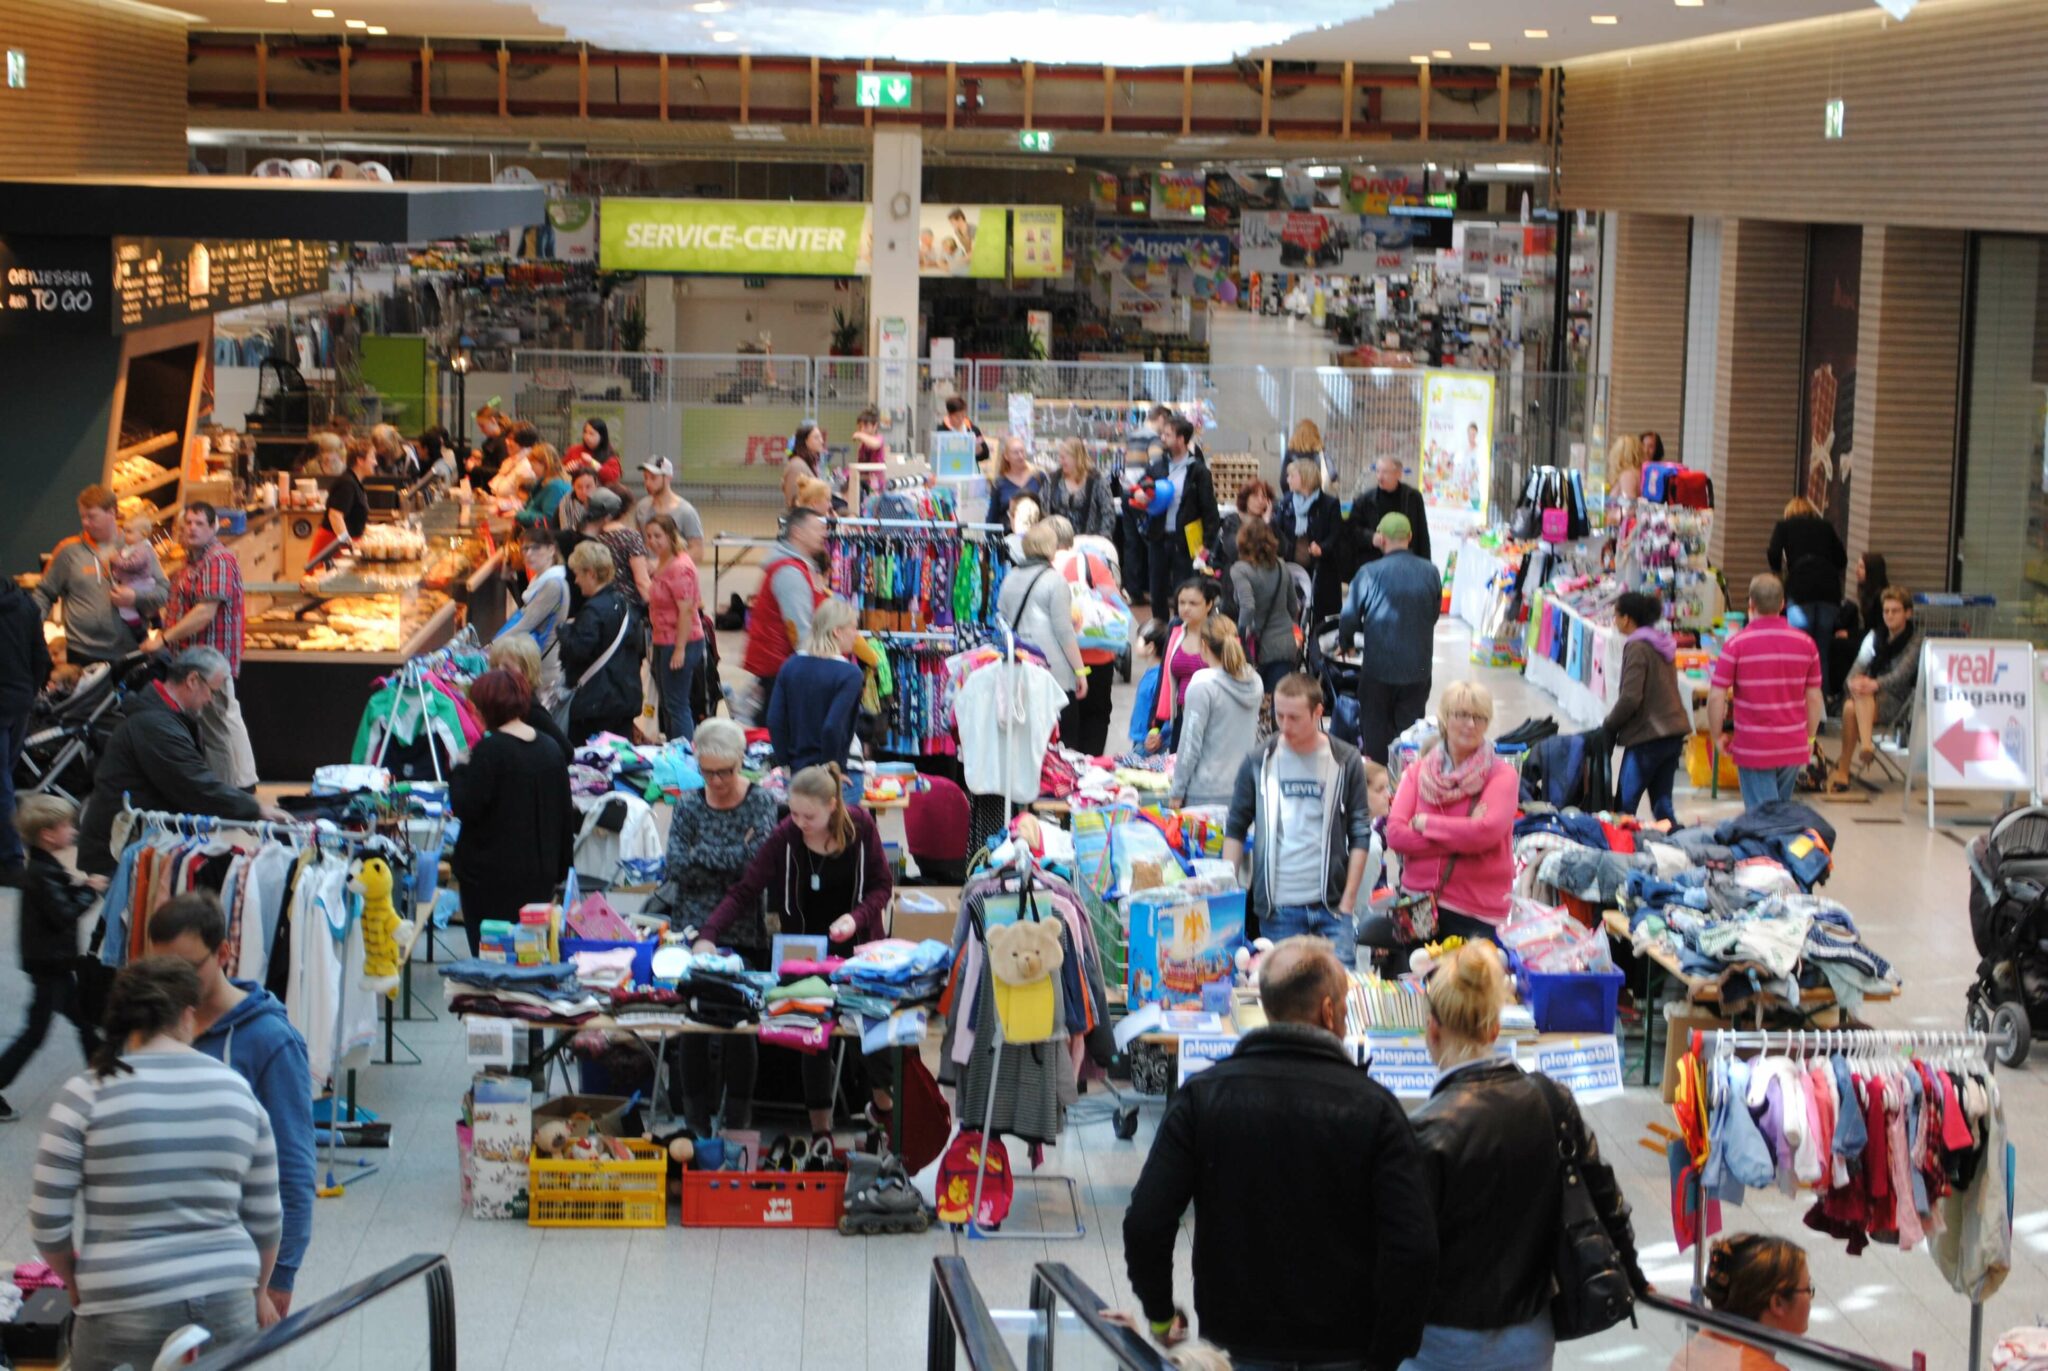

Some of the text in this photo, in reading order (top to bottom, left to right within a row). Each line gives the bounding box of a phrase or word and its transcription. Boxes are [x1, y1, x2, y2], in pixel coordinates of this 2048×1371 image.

[624, 223, 847, 251] SERVICE-CENTER
[31, 288, 57, 311] TO
[61, 289, 92, 312] GO
[1933, 686, 2026, 709] Eingang
[1541, 1045, 1614, 1071] playmobil
